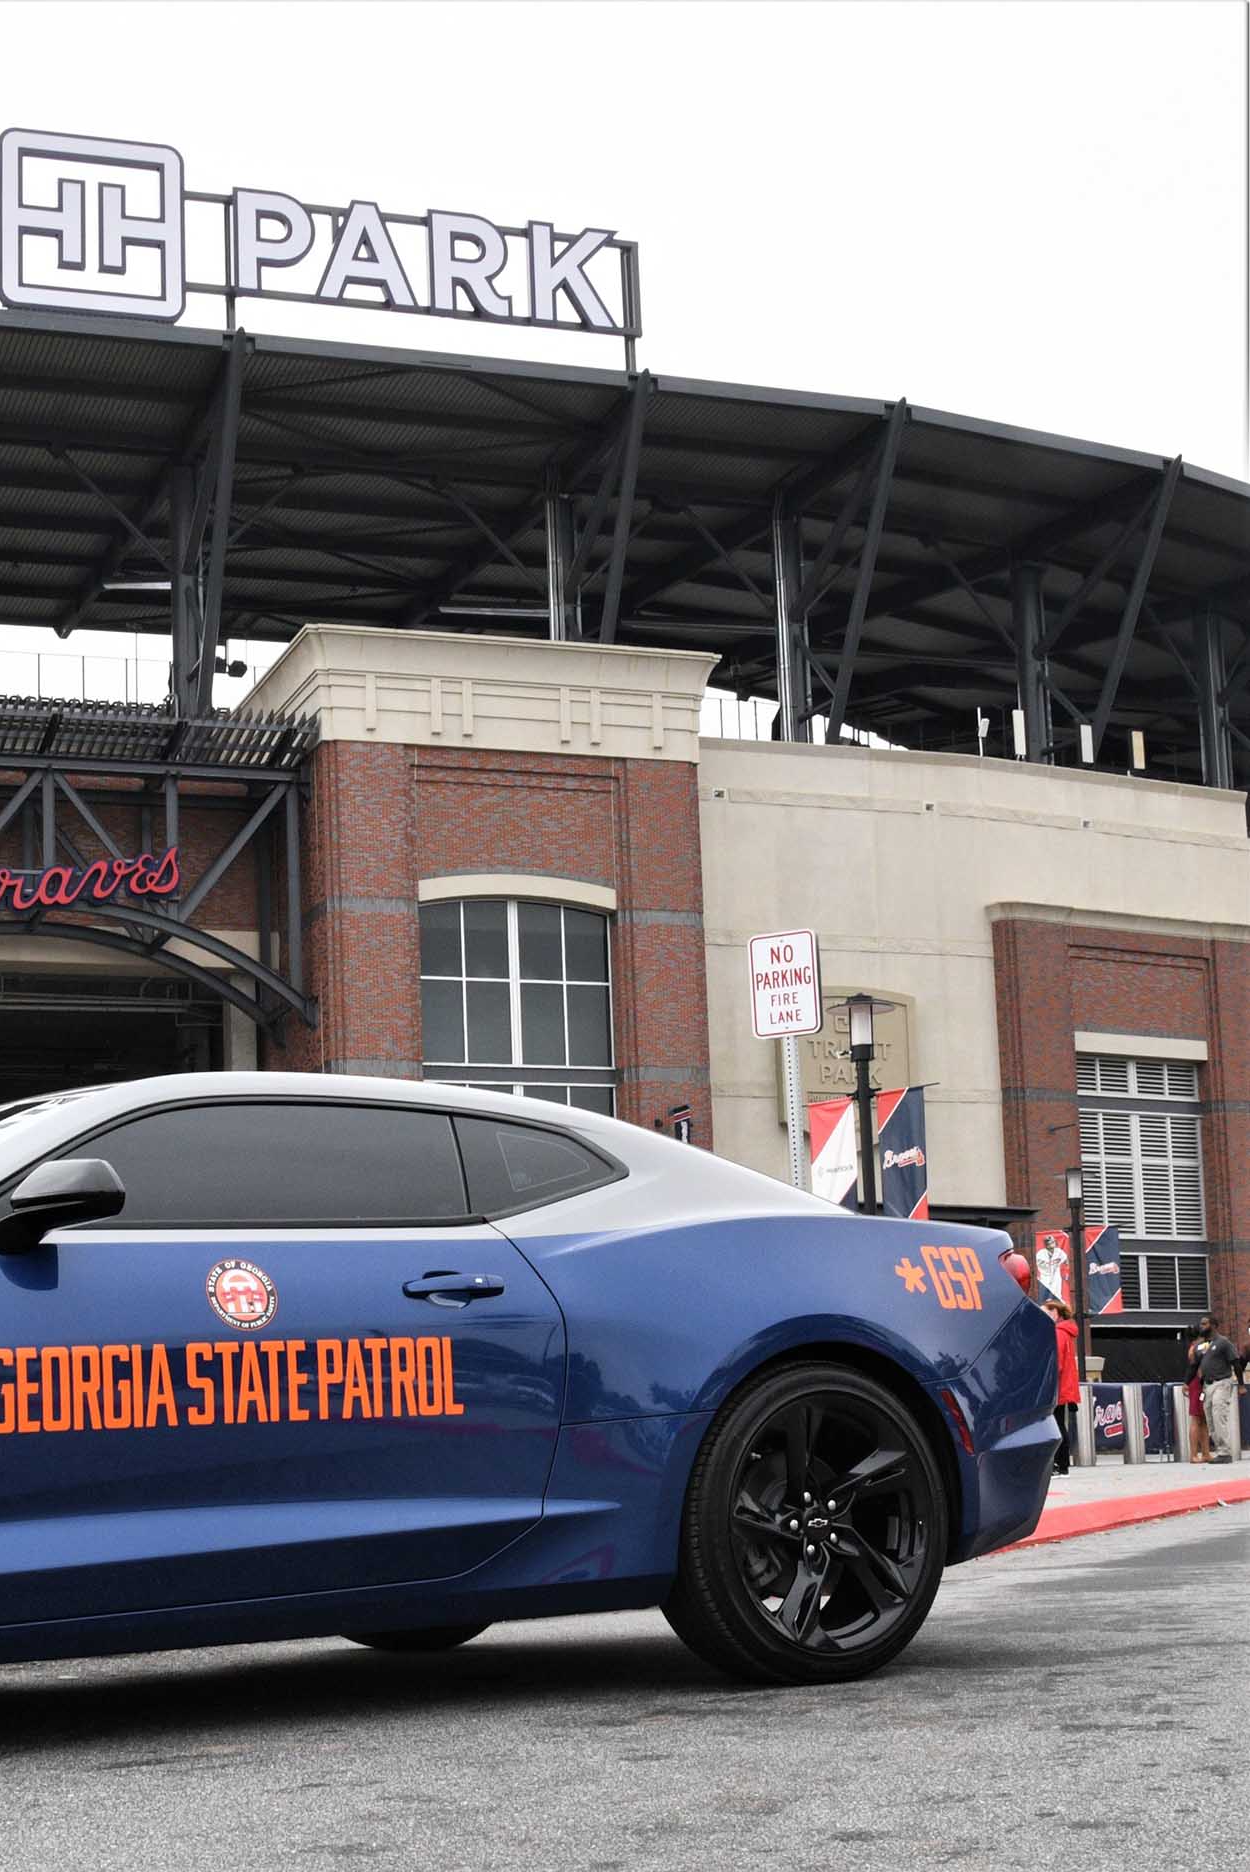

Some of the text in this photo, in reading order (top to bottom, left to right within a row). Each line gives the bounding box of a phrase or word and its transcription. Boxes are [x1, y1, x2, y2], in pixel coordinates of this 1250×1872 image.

[232, 187, 619, 330] PARK
[770, 944, 794, 965] NO
[756, 966, 812, 991] PARKING
[771, 992, 798, 1007] FIRE
[770, 1009, 802, 1025] LANE
[186, 1340, 310, 1425] STATE
[317, 1336, 465, 1420] PATROL
